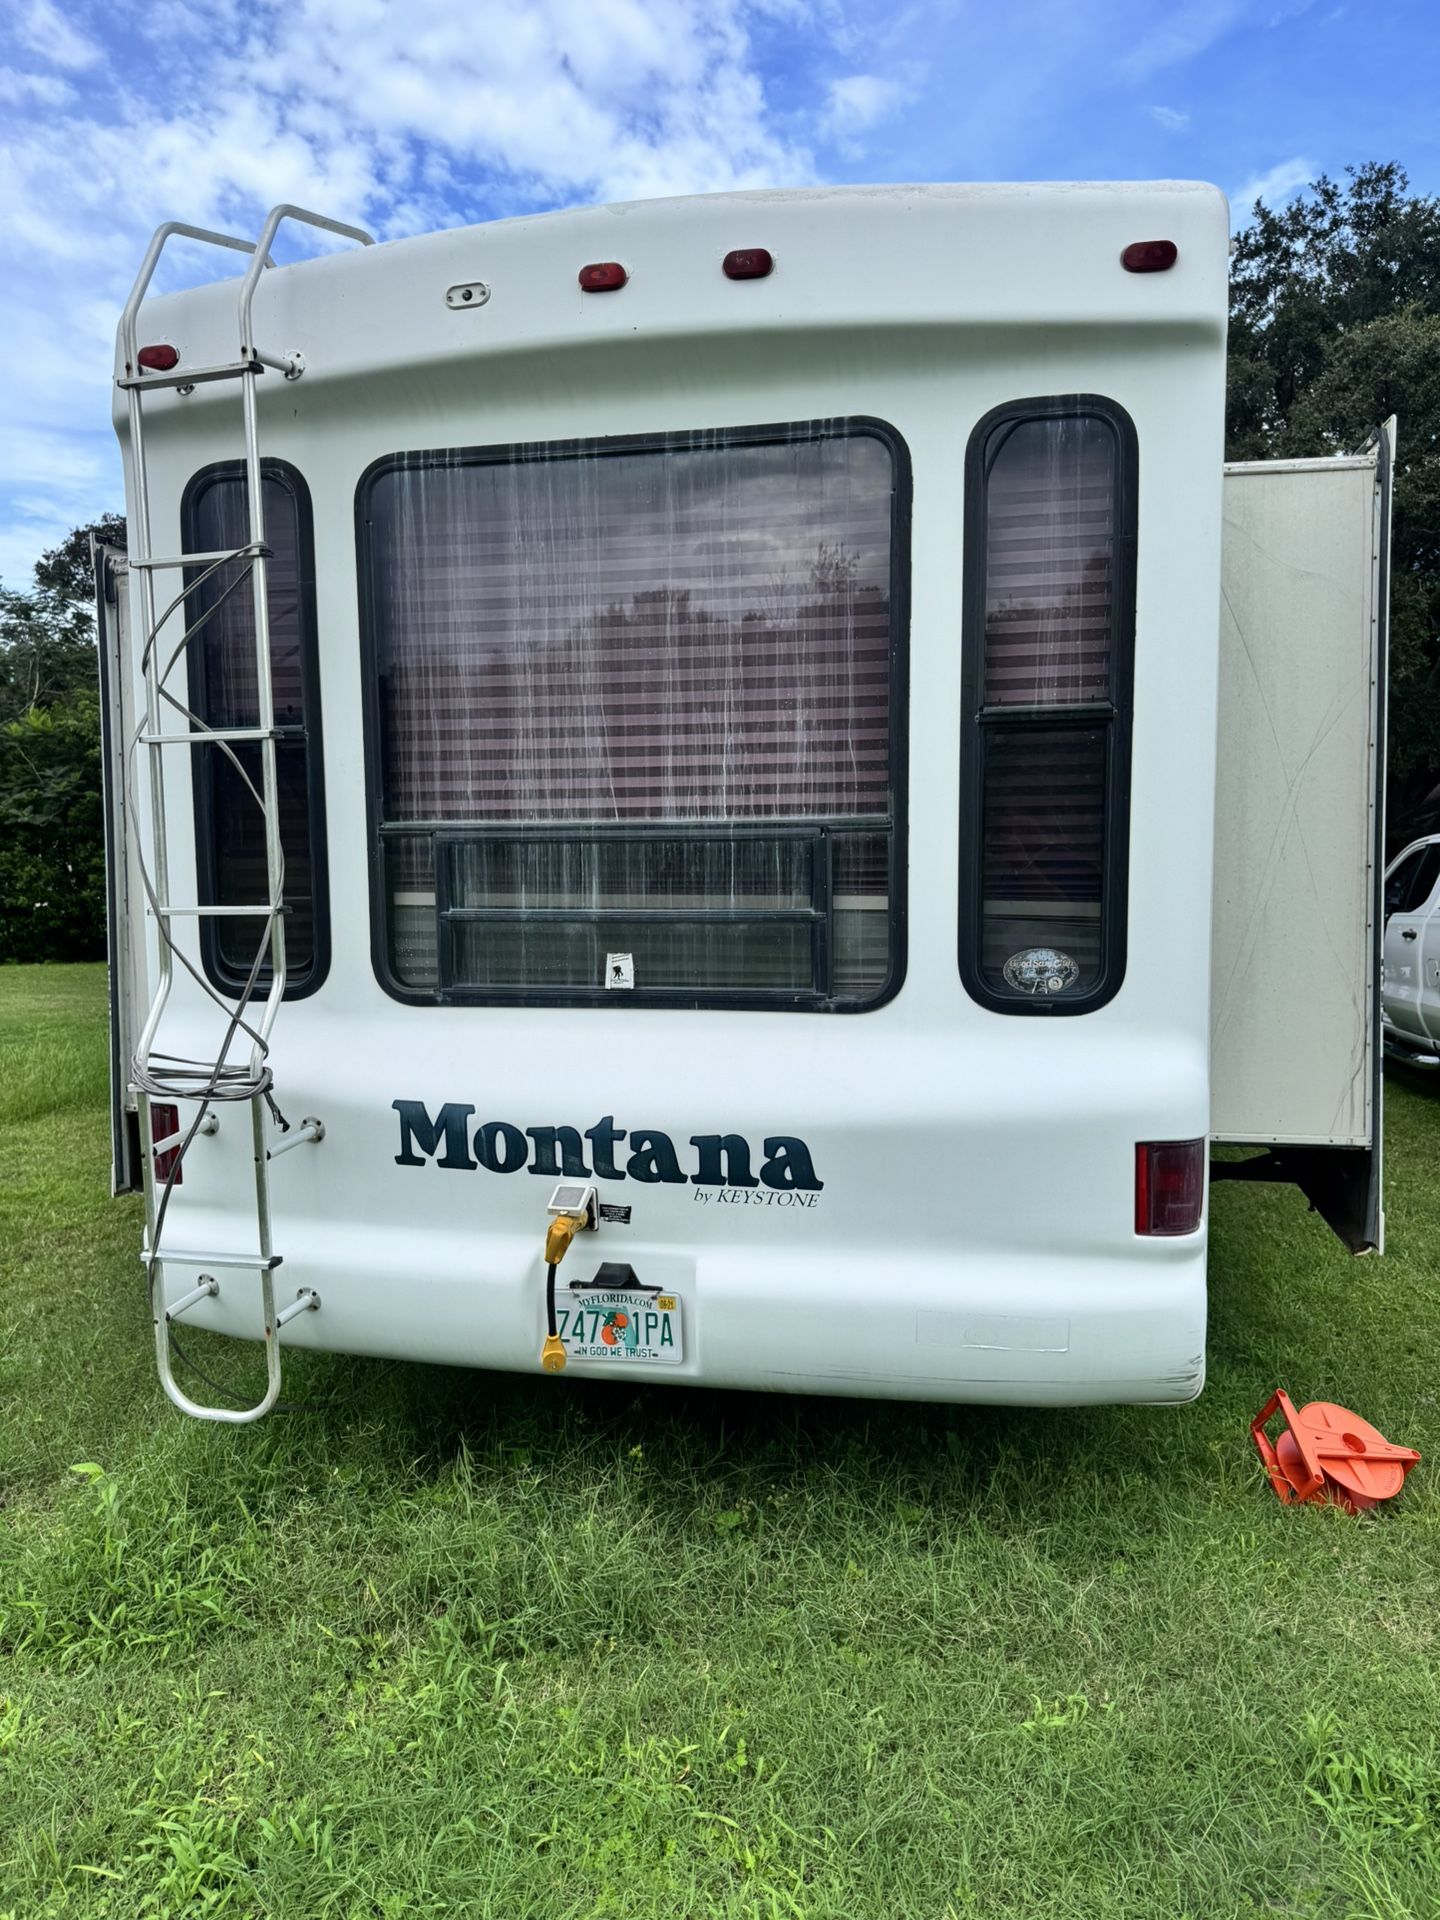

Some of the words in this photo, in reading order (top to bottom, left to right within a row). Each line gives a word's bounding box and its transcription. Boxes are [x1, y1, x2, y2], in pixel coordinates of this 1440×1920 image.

[392, 1099, 824, 1191] Montana
[694, 1188, 713, 1205] by
[717, 1189, 820, 1208] KEYSTONE
[578, 1294, 653, 1310] MYFLORIDA.COM
[580, 1347, 588, 1356] IN
[590, 1347, 608, 1356] GOD
[611, 1347, 622, 1357] WE
[625, 1347, 652, 1358] TRUST
